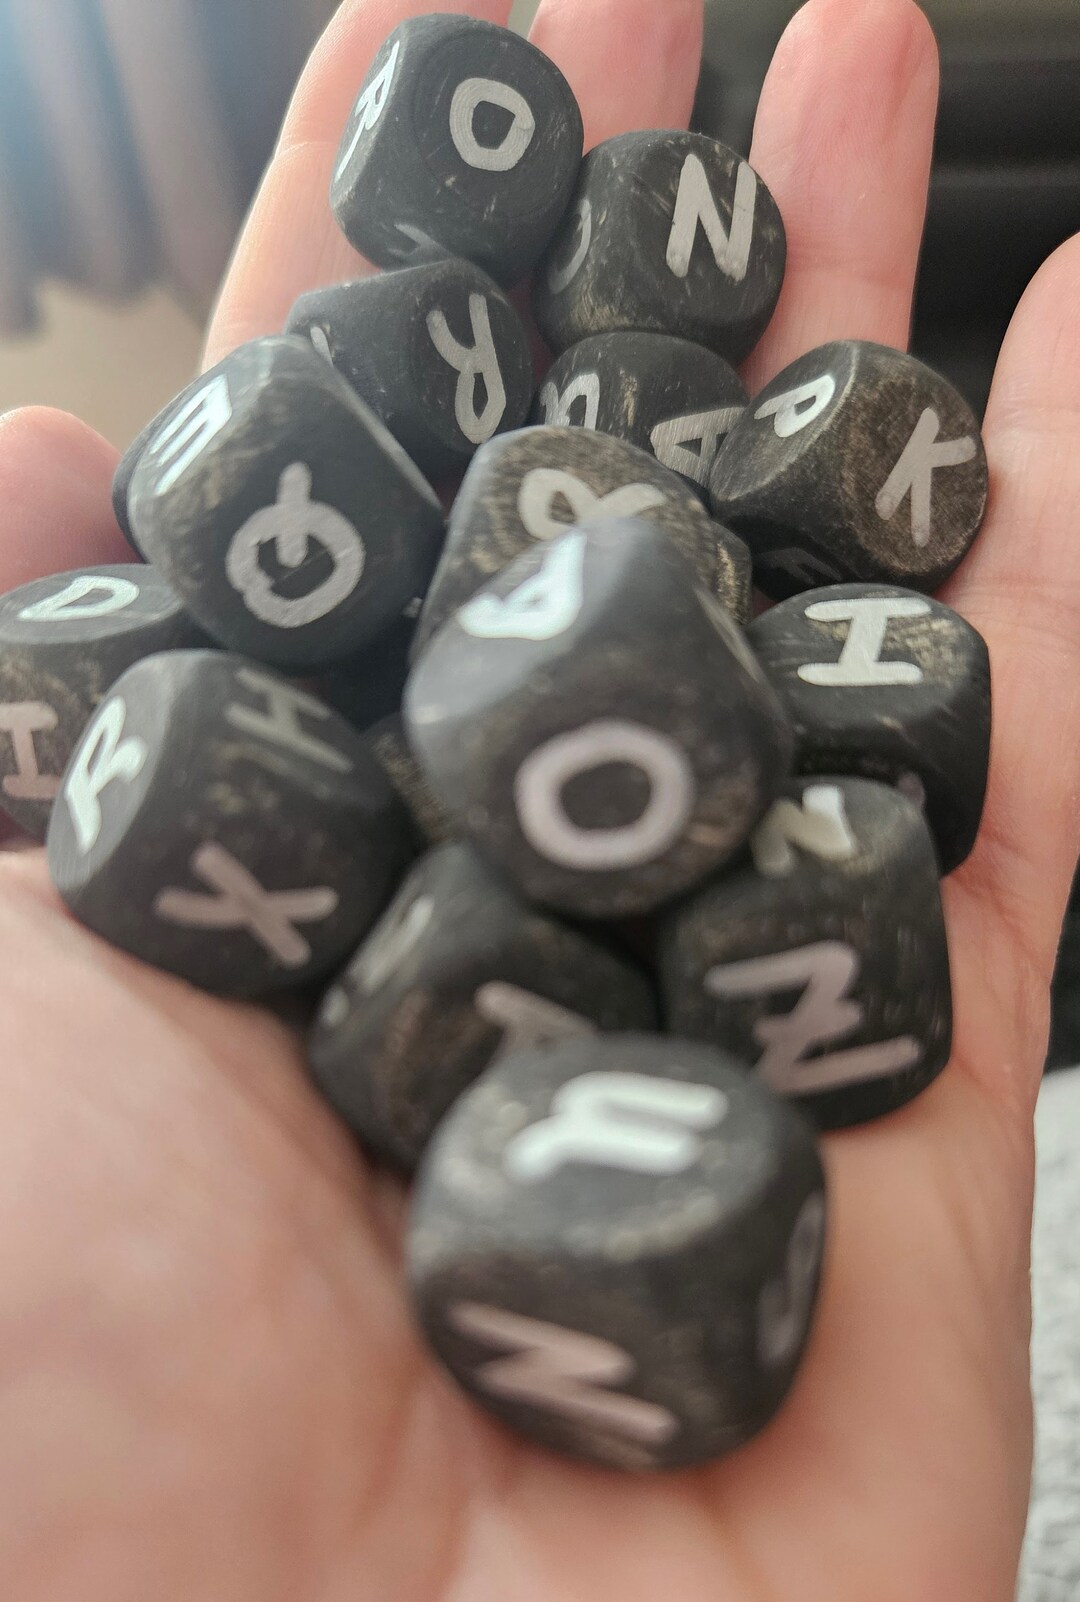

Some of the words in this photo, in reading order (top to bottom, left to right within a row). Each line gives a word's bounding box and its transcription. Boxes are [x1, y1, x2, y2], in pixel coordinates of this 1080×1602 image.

[449, 77, 536, 172] O
[666, 153, 757, 281] N
[650, 406, 746, 488] A
[754, 374, 836, 438] P
[874, 407, 977, 547] K
[225, 462, 366, 629] Q
[64, 696, 149, 855] R
[514, 718, 694, 872] O
[155, 841, 338, 968] X
